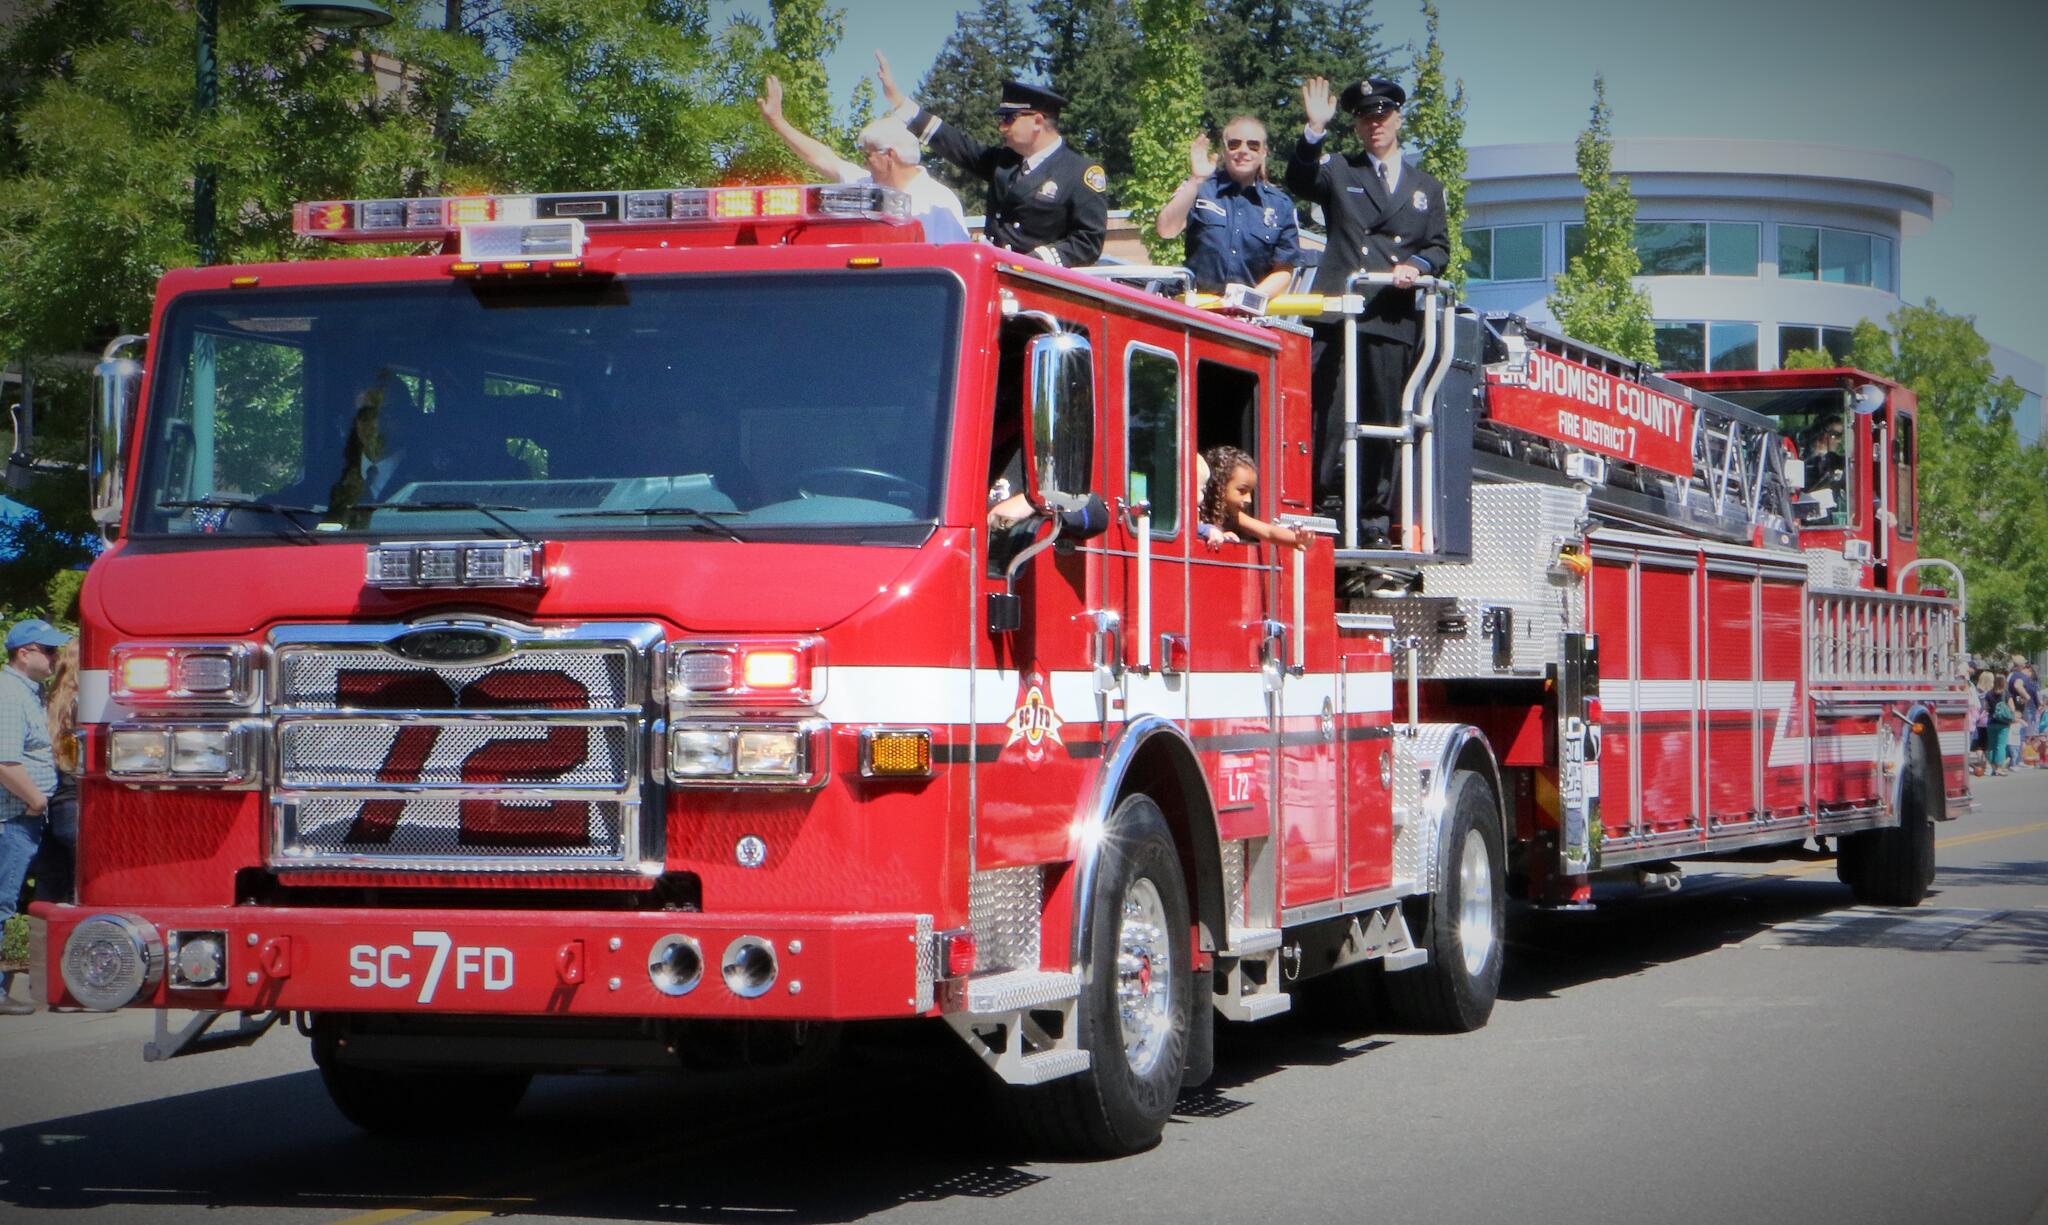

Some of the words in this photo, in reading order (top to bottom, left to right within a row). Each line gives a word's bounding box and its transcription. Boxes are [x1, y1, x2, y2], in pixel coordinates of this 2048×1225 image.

[1558, 410, 1580, 439] FIRE
[1583, 416, 1625, 452] DISTRICT
[1628, 427, 1636, 459] 7
[1616, 383, 1683, 442] COUNTY
[336, 667, 591, 847] 72
[1228, 772, 1249, 802] L72
[349, 931, 514, 1004] SC7FD
